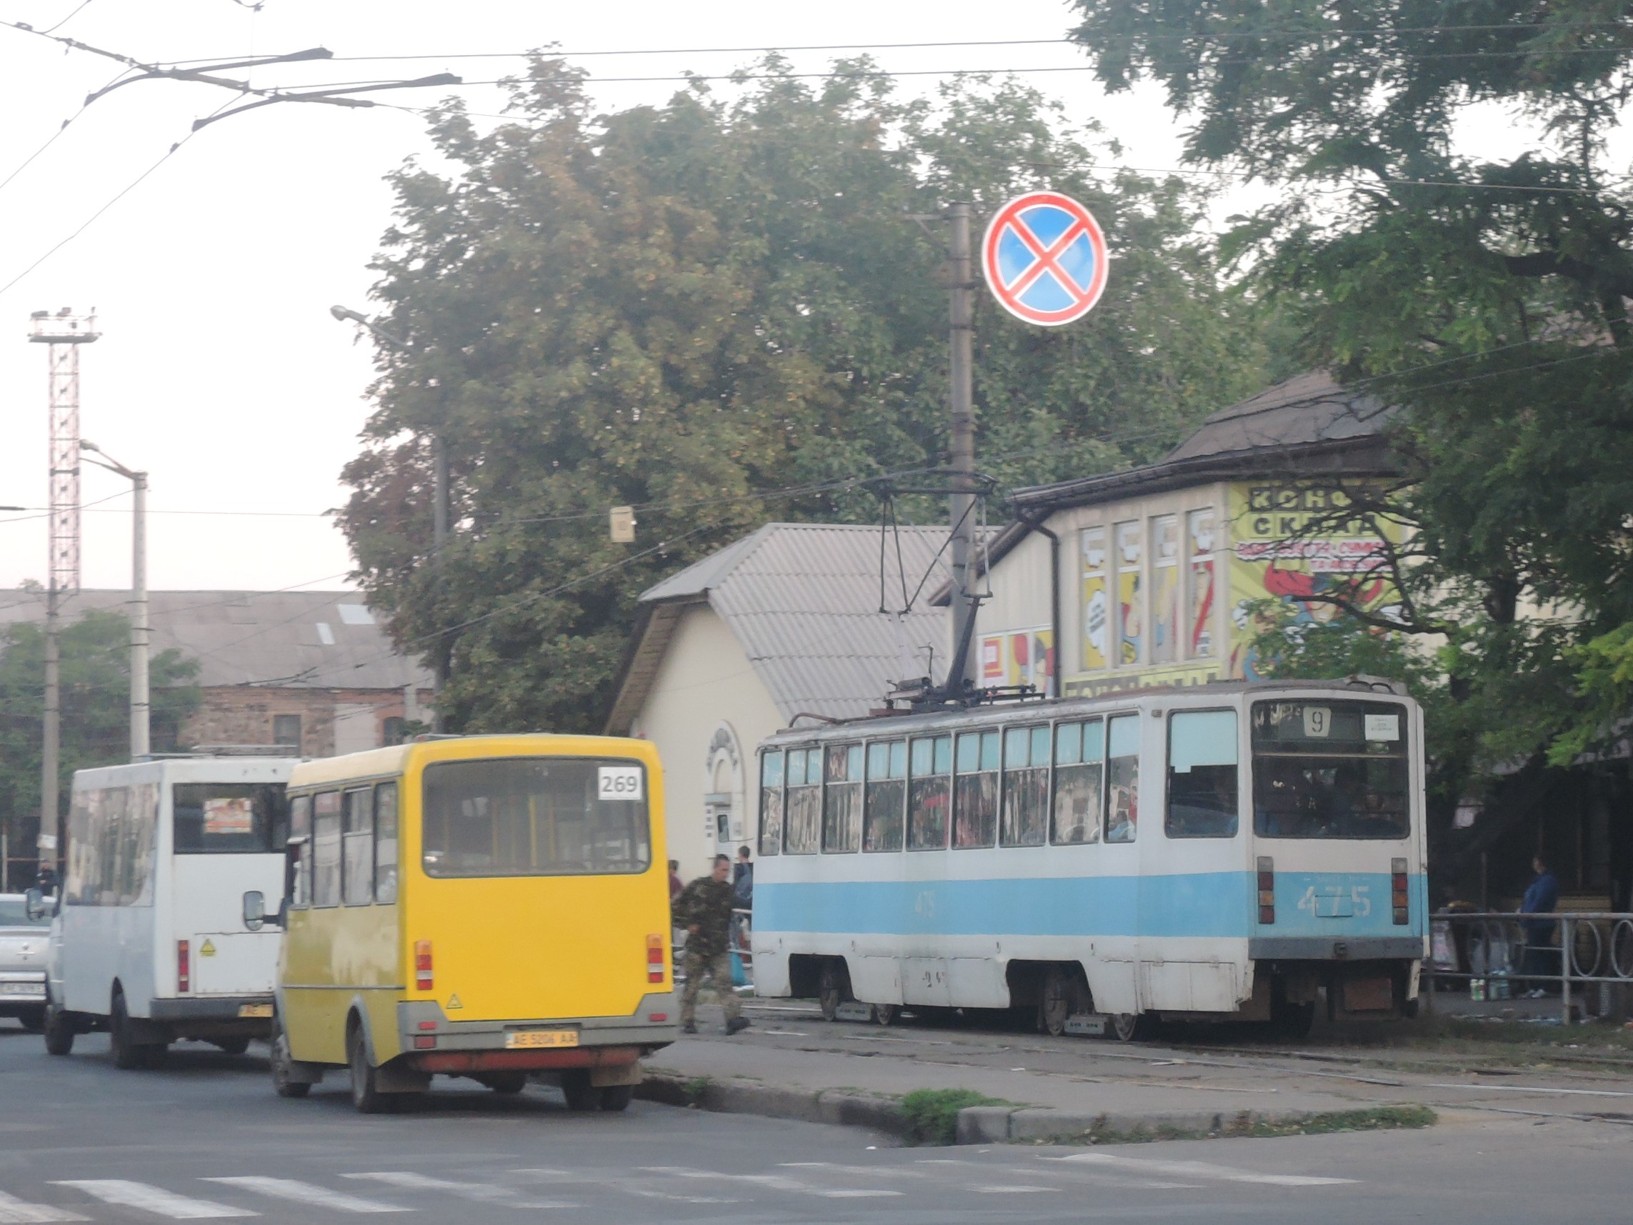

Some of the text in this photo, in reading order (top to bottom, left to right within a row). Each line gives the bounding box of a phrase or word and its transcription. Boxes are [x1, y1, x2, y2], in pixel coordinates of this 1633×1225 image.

[1311, 711, 1324, 732] 9
[601, 775, 638, 793] 269
[1296, 885, 1371, 917] 475
